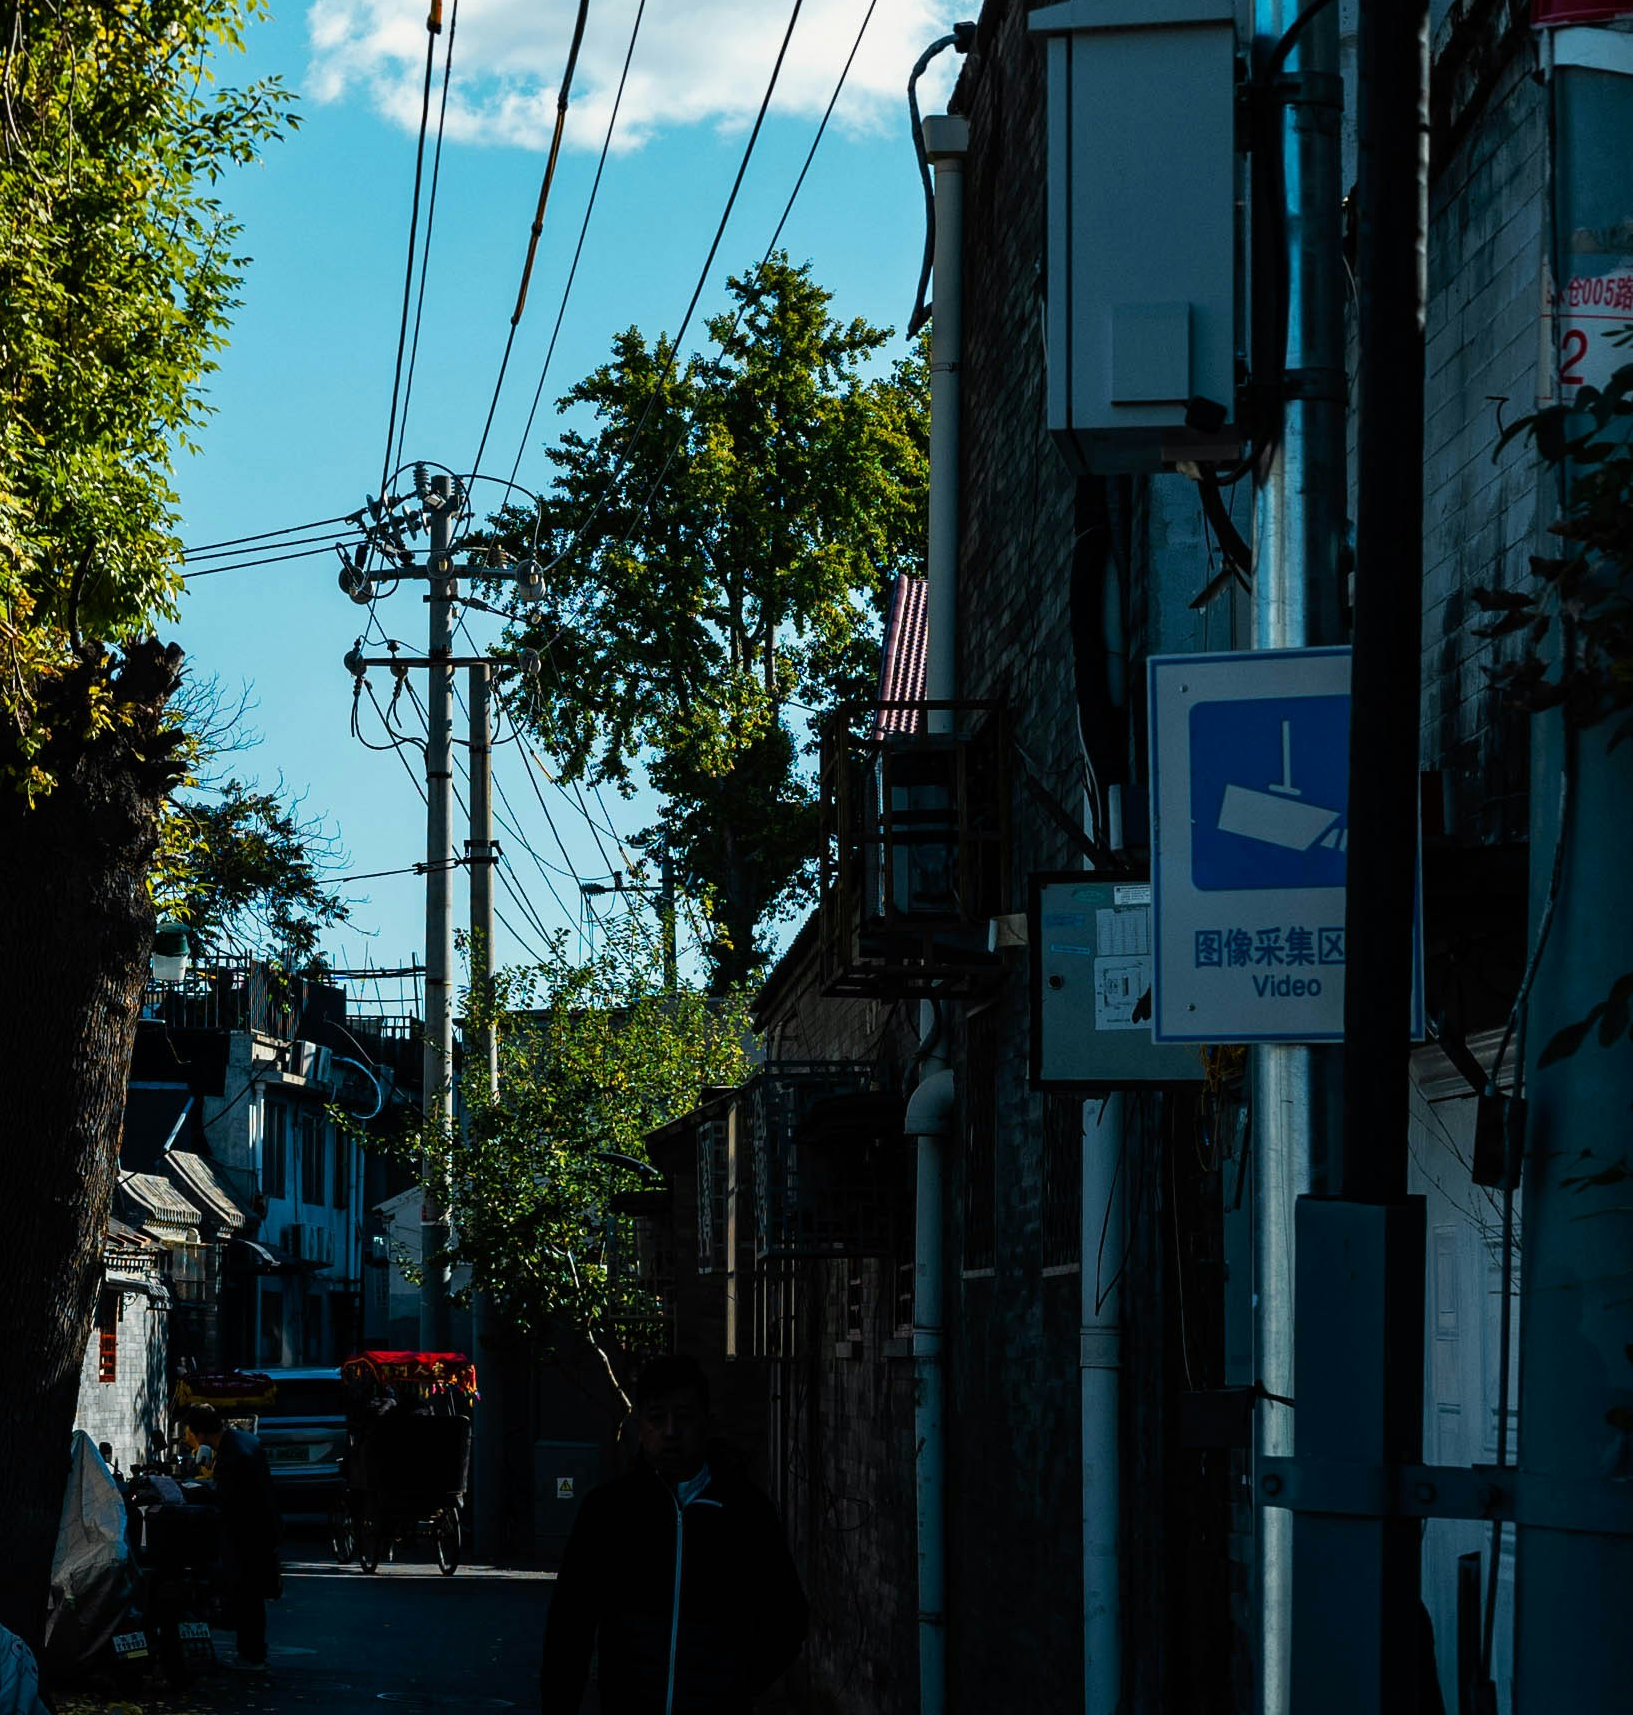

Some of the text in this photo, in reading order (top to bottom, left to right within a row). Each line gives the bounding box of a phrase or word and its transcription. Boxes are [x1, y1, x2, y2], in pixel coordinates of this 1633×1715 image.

[1560, 329, 1588, 385] 2
[1195, 926, 1346, 968] 图像采集区
[1253, 974, 1322, 998] Video
